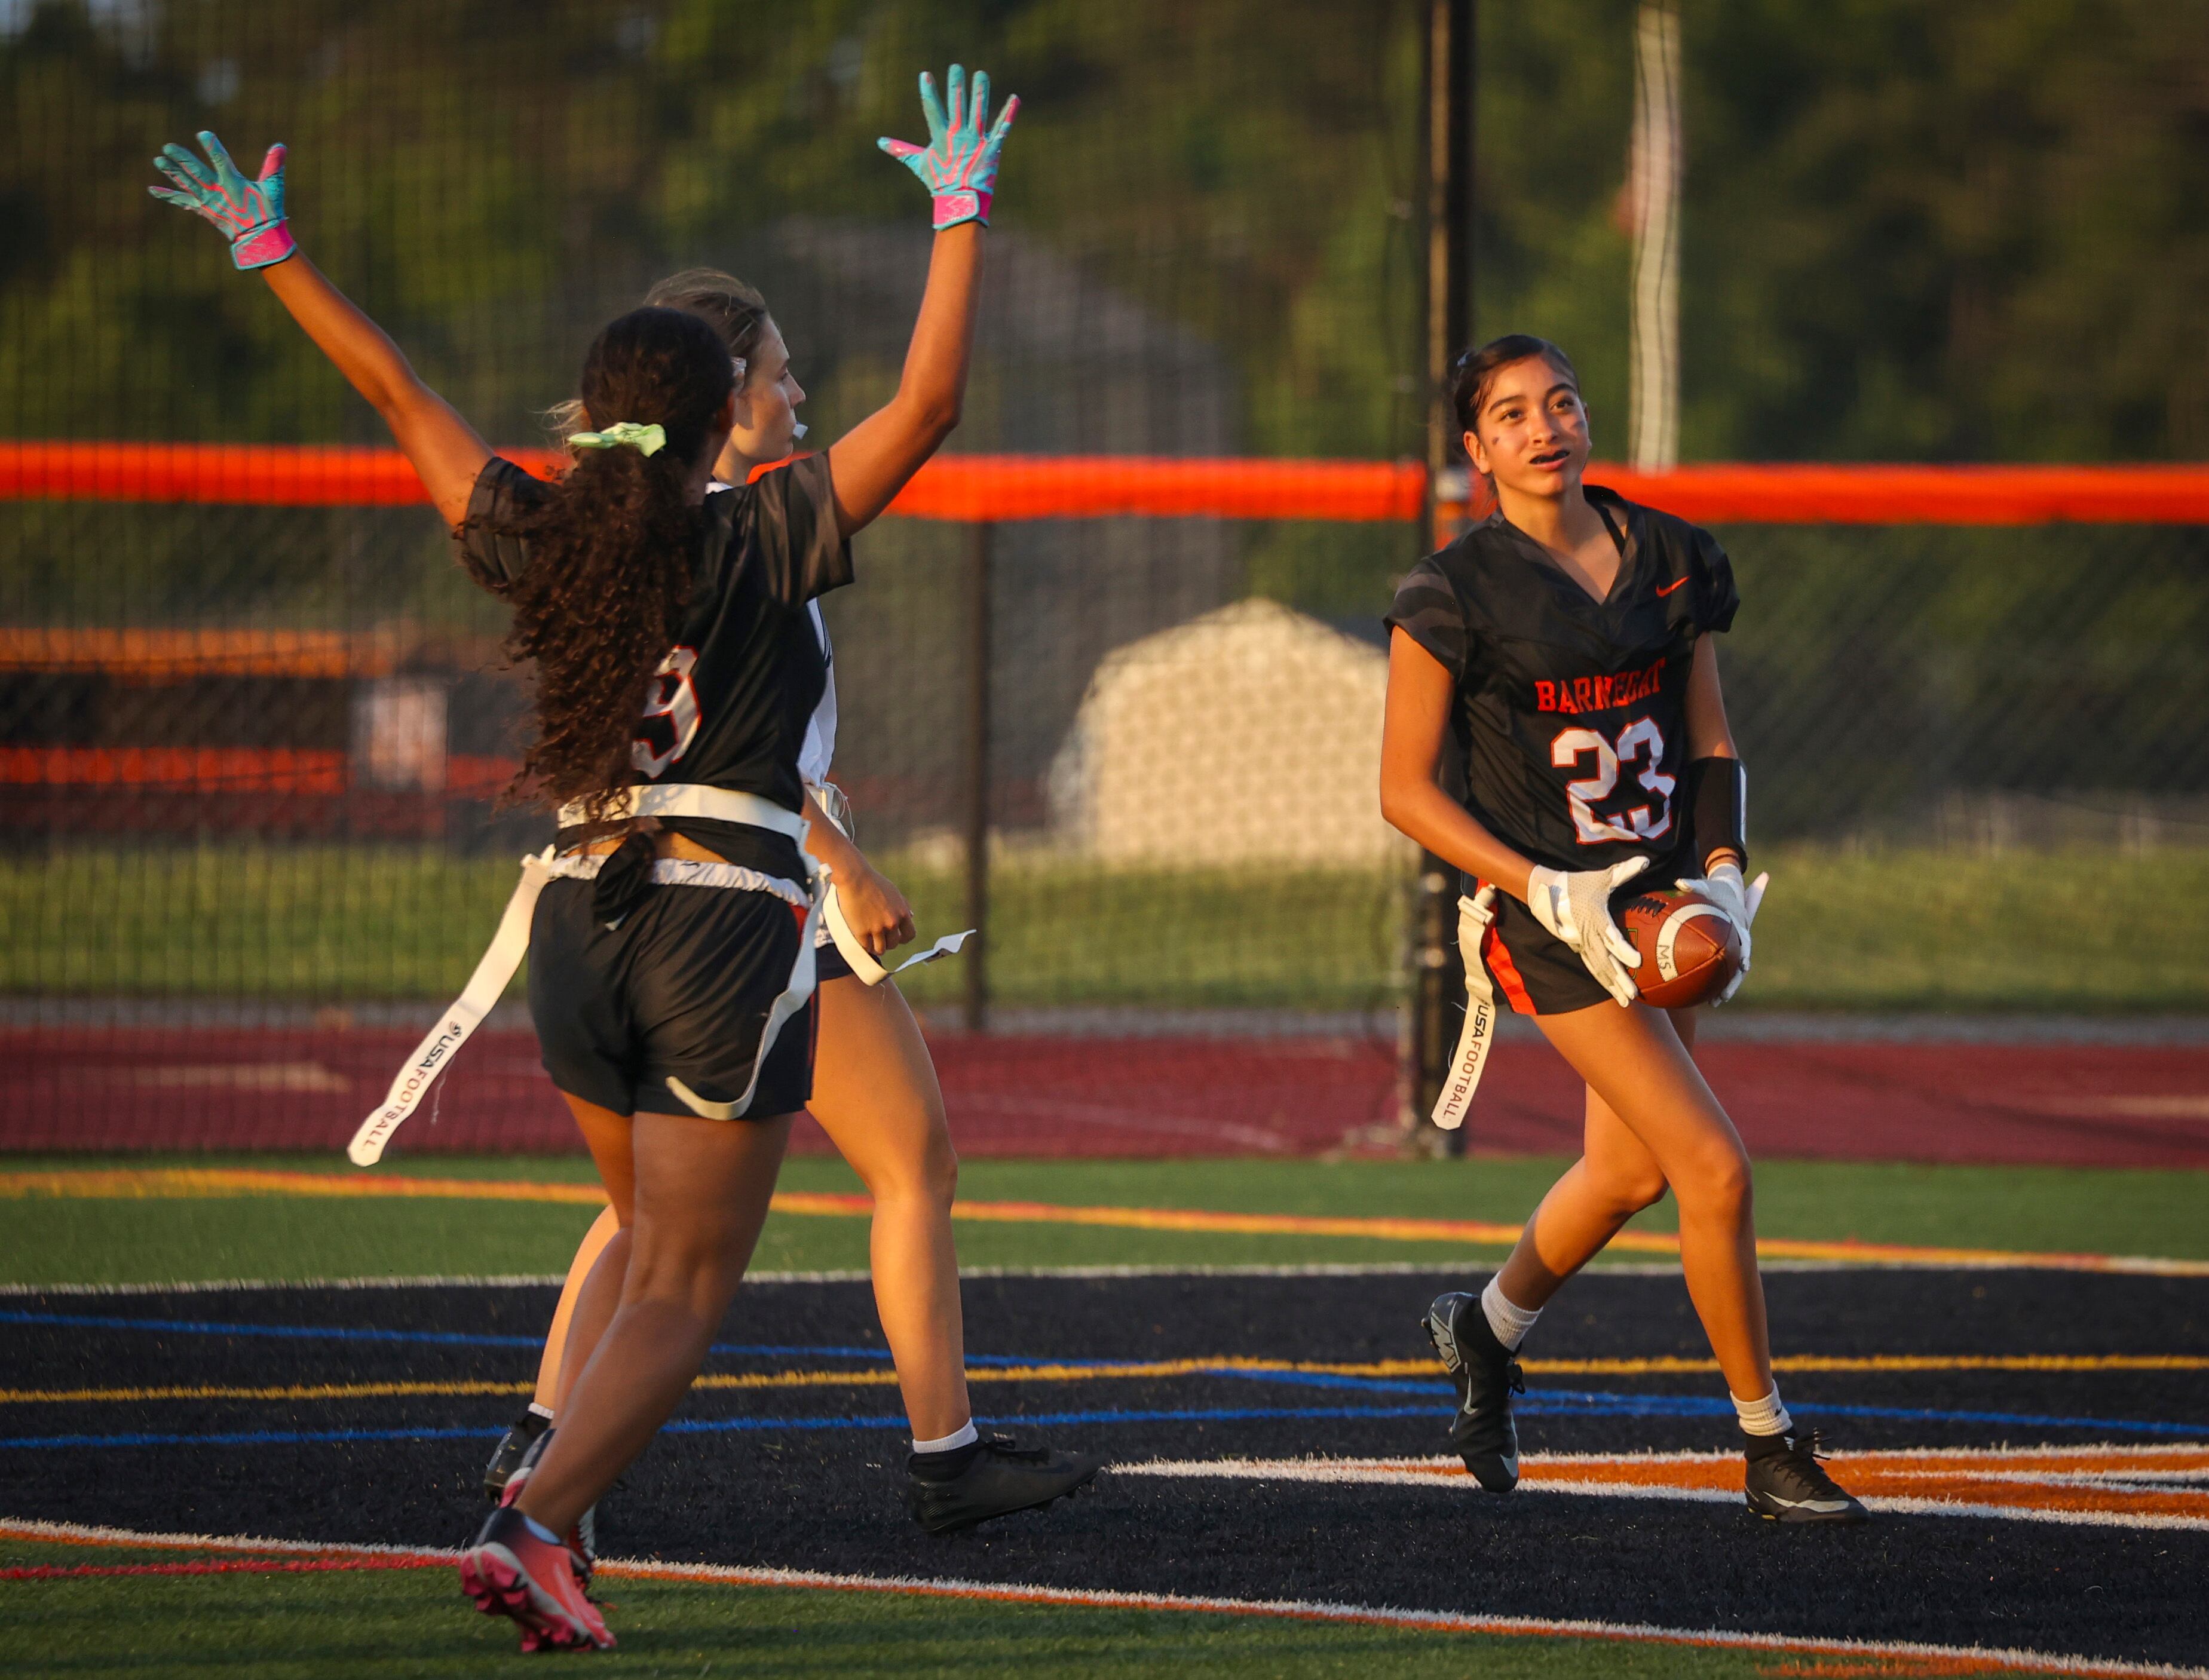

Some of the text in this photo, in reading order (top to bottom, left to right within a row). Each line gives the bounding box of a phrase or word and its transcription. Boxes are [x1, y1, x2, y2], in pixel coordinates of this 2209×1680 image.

[1534, 657, 1666, 715] BARNEGAT
[1550, 715, 1677, 845] 23
[363, 1034, 455, 1147] USA FOOTBALL
[1443, 1004, 1489, 1117] USA FOOTBALL
